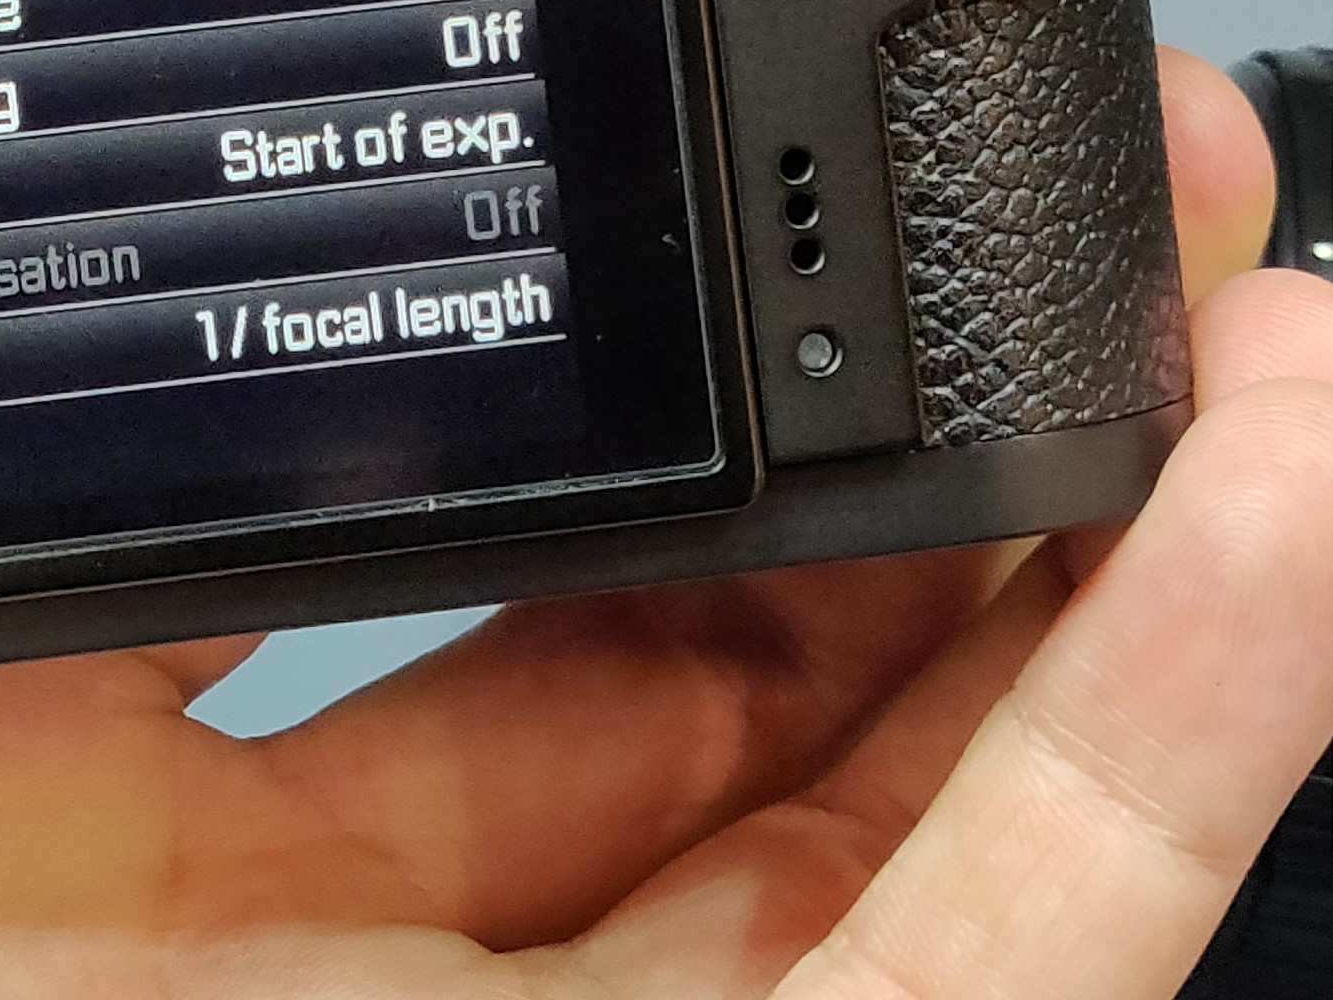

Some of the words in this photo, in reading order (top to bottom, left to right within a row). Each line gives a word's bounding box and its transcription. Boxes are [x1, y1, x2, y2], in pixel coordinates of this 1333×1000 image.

[443, 14, 524, 71] Off
[221, 125, 343, 182] Start
[355, 114, 408, 166] of
[422, 112, 535, 174] exp.
[464, 188, 543, 241] Off
[265, 291, 382, 353] focal
[396, 274, 552, 343] length
